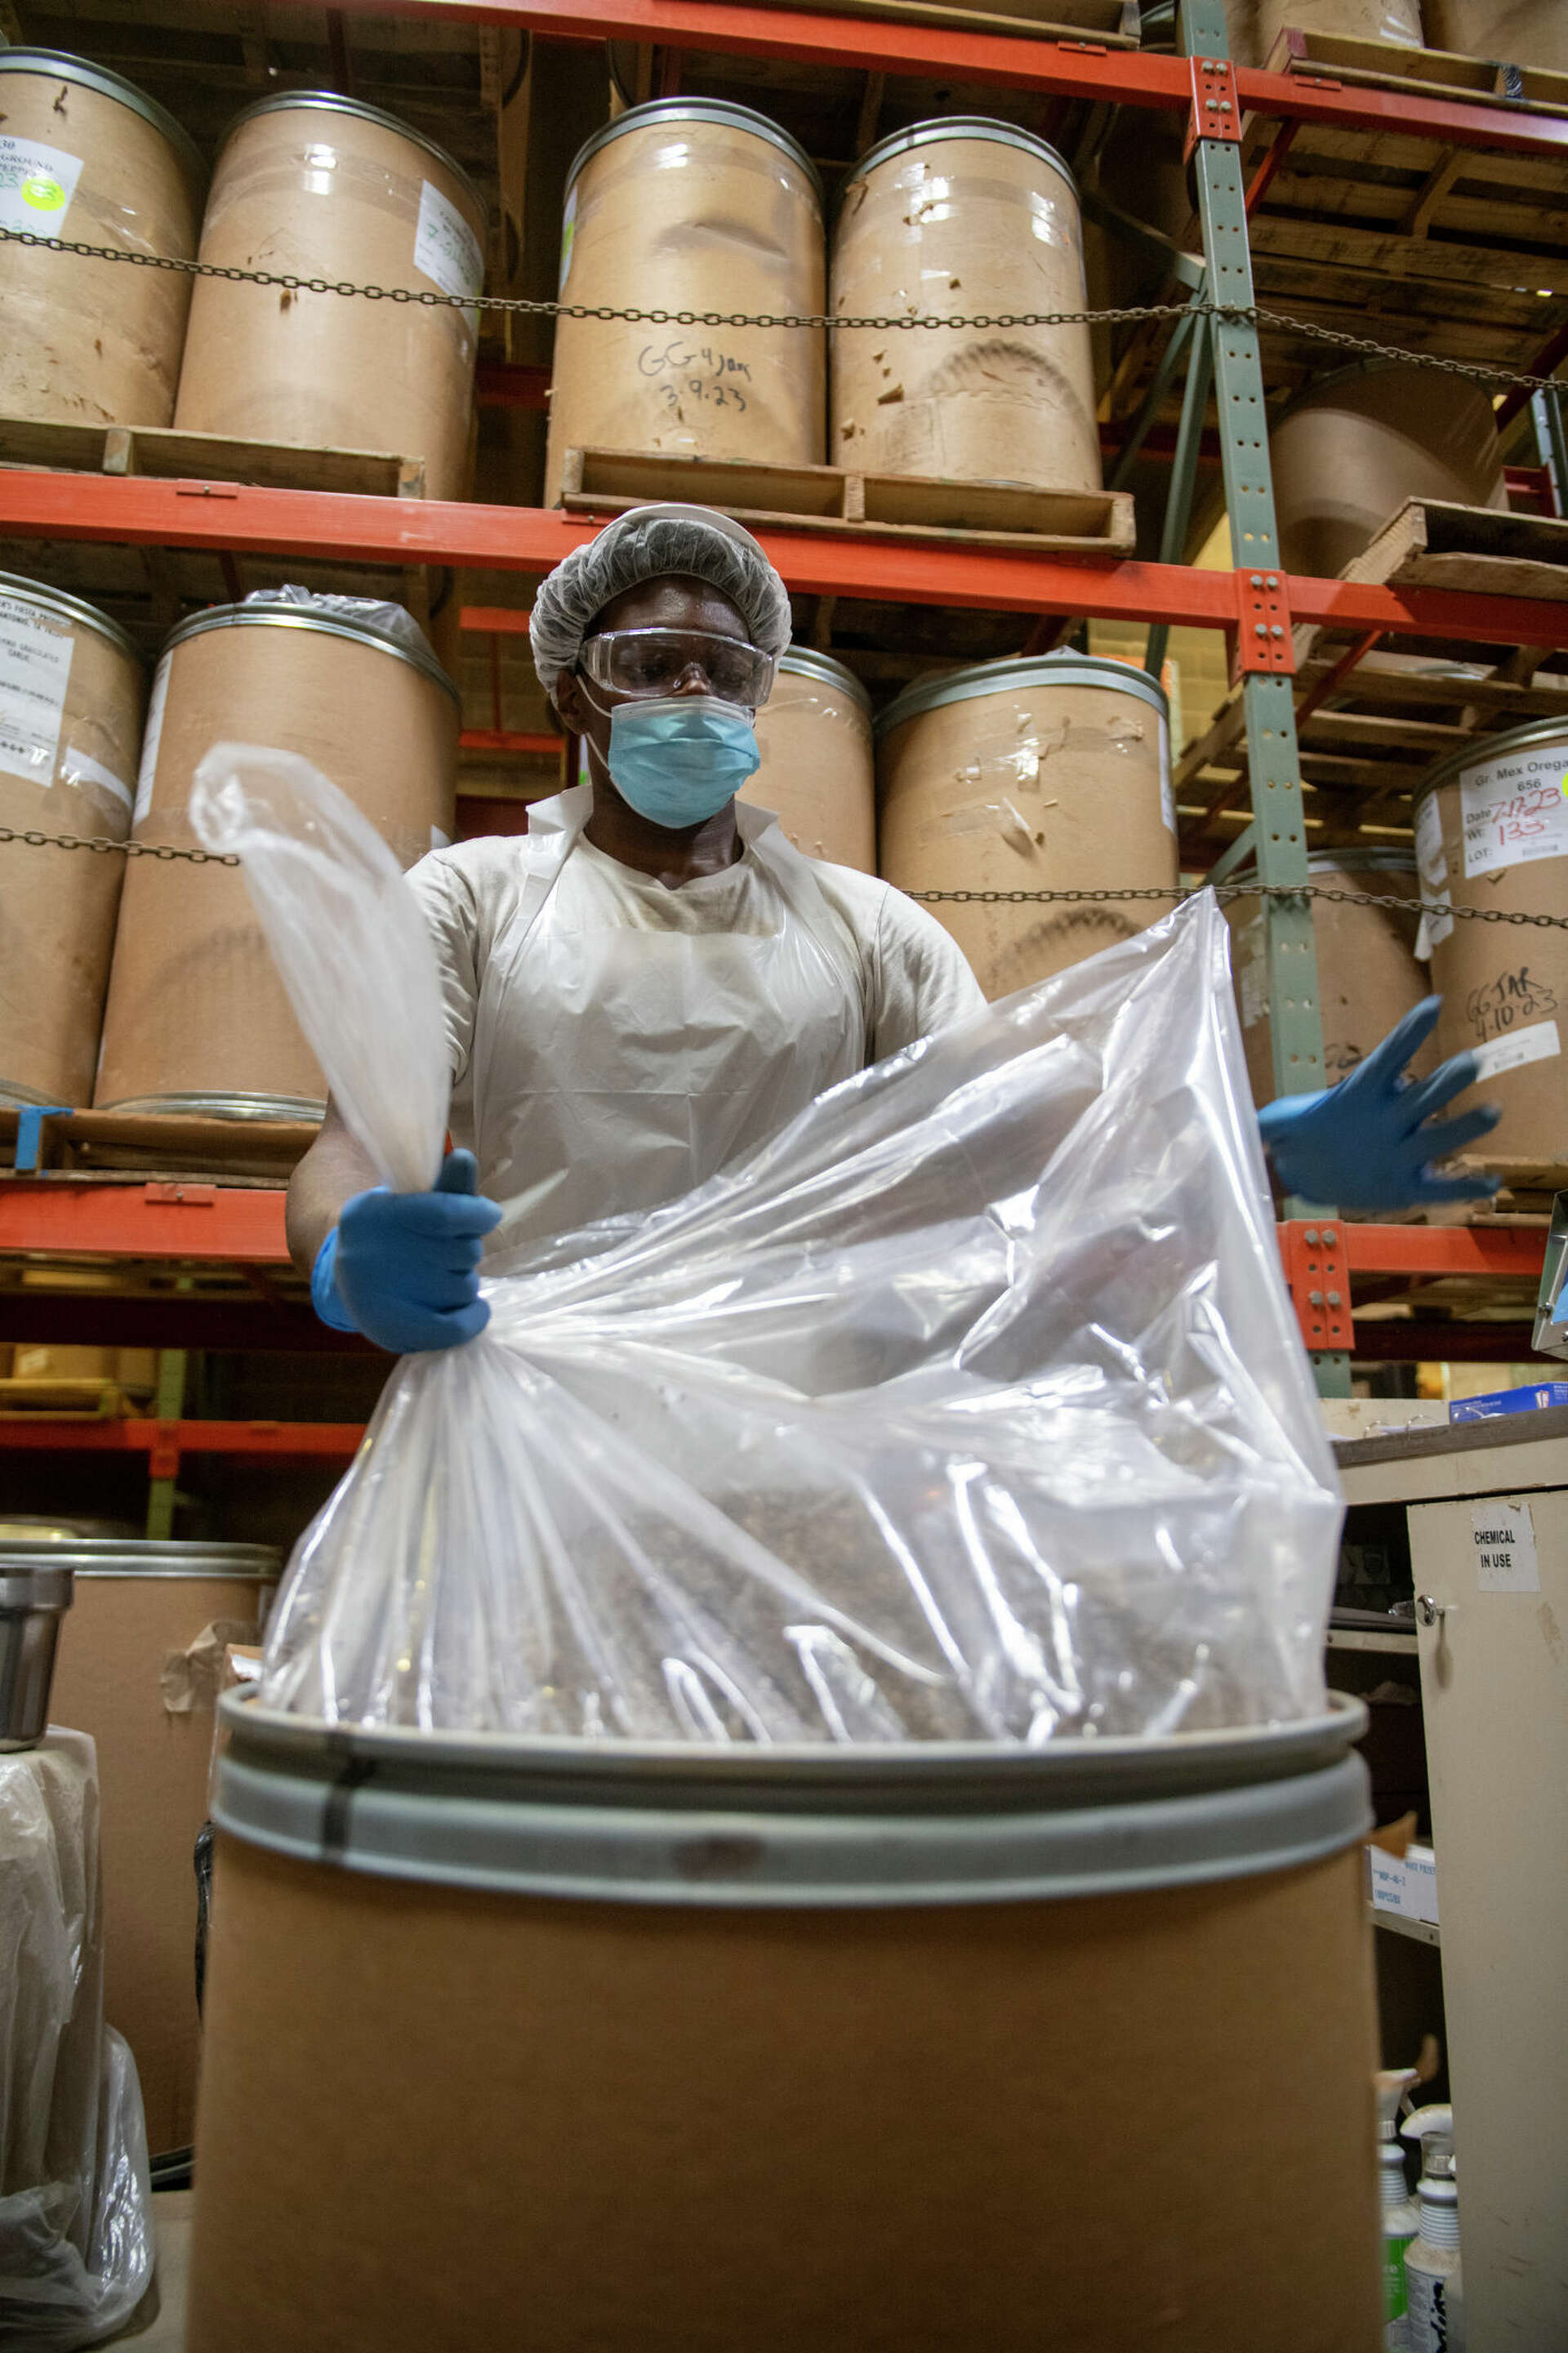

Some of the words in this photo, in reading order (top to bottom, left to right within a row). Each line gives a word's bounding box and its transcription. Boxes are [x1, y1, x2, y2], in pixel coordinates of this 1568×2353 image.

[1496, 767, 1523, 780] Mex
[1527, 760, 1568, 772] Orega
[1517, 778, 1542, 791] 656
[1474, 1530, 1516, 1544] CHEMICAL
[1481, 1553, 1490, 1568] IN
[1493, 1553, 1512, 1568] USE
